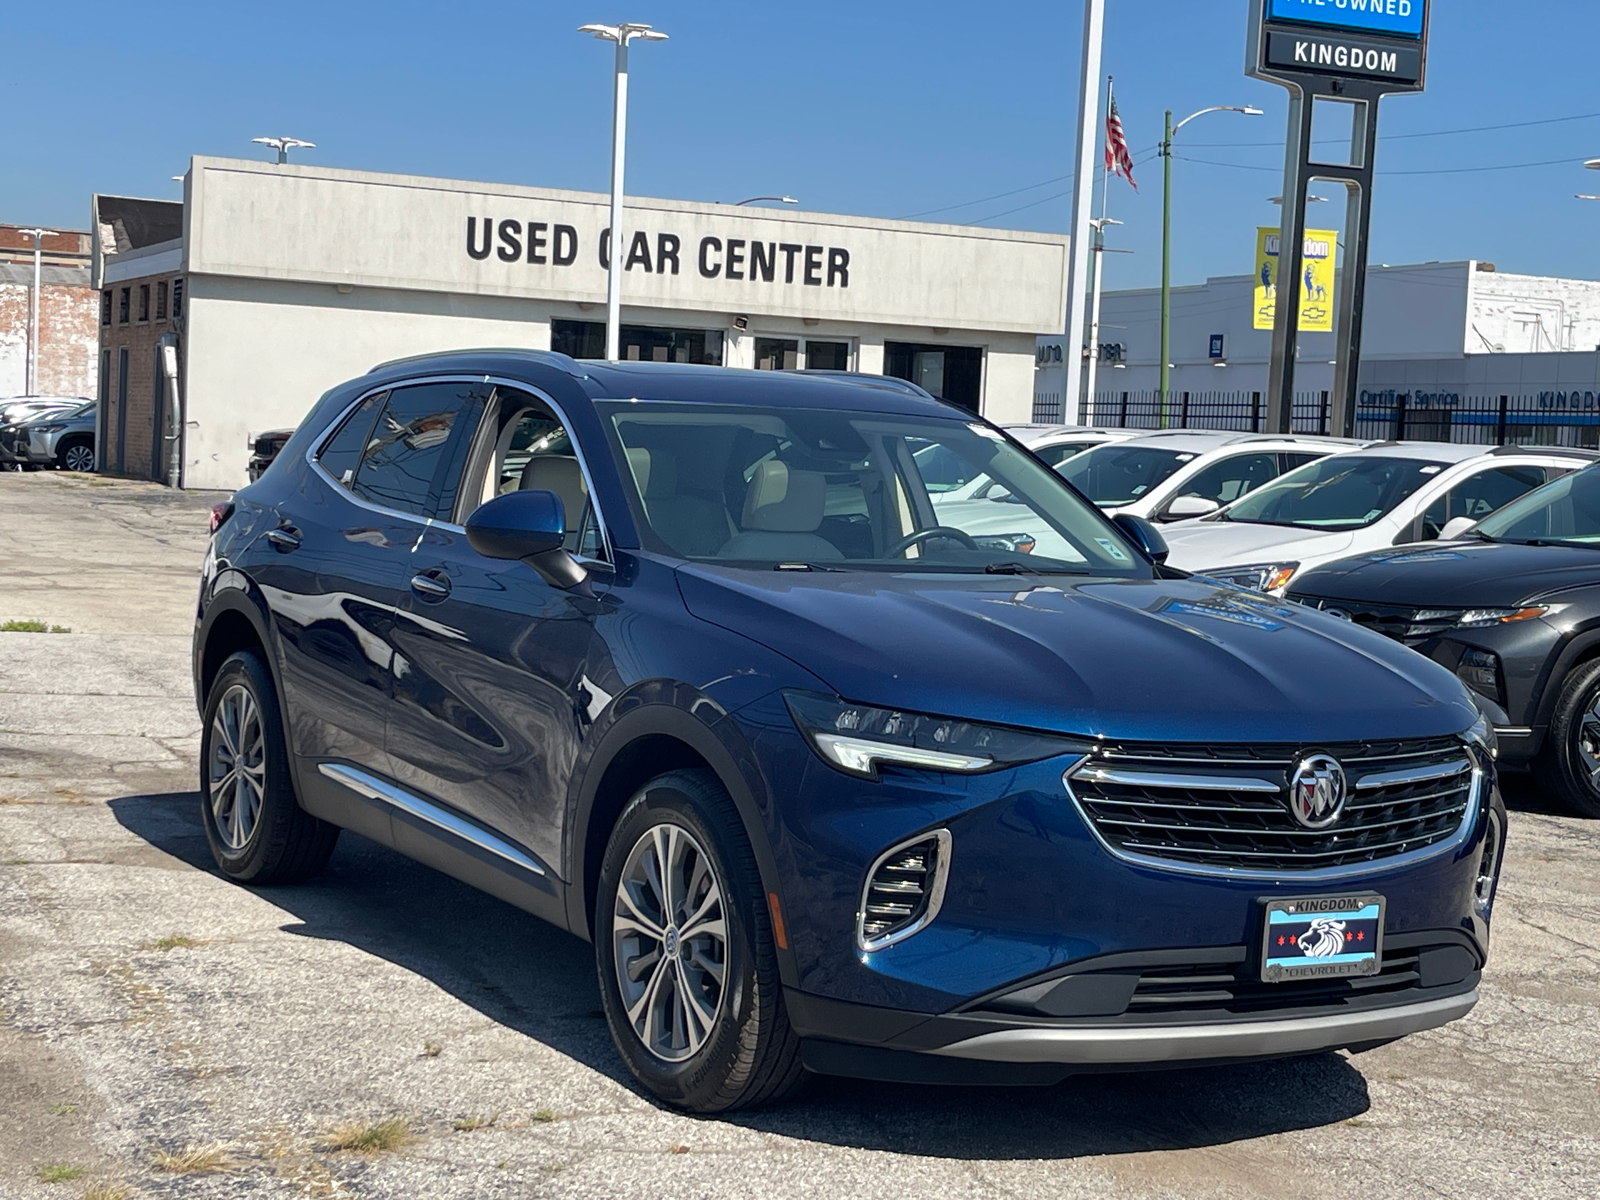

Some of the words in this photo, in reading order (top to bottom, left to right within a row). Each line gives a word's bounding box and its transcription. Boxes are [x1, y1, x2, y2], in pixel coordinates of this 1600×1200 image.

[1287, 0, 1411, 17] -OWNED
[1294, 41, 1397, 73] KINGDOM
[466, 216, 578, 267] USED
[599, 227, 680, 275] CAR
[698, 236, 850, 288] CENTER
[1539, 391, 1600, 409] KINGD
[1295, 898, 1358, 912] KINGDOM
[1289, 964, 1351, 977] CHEVROLET
